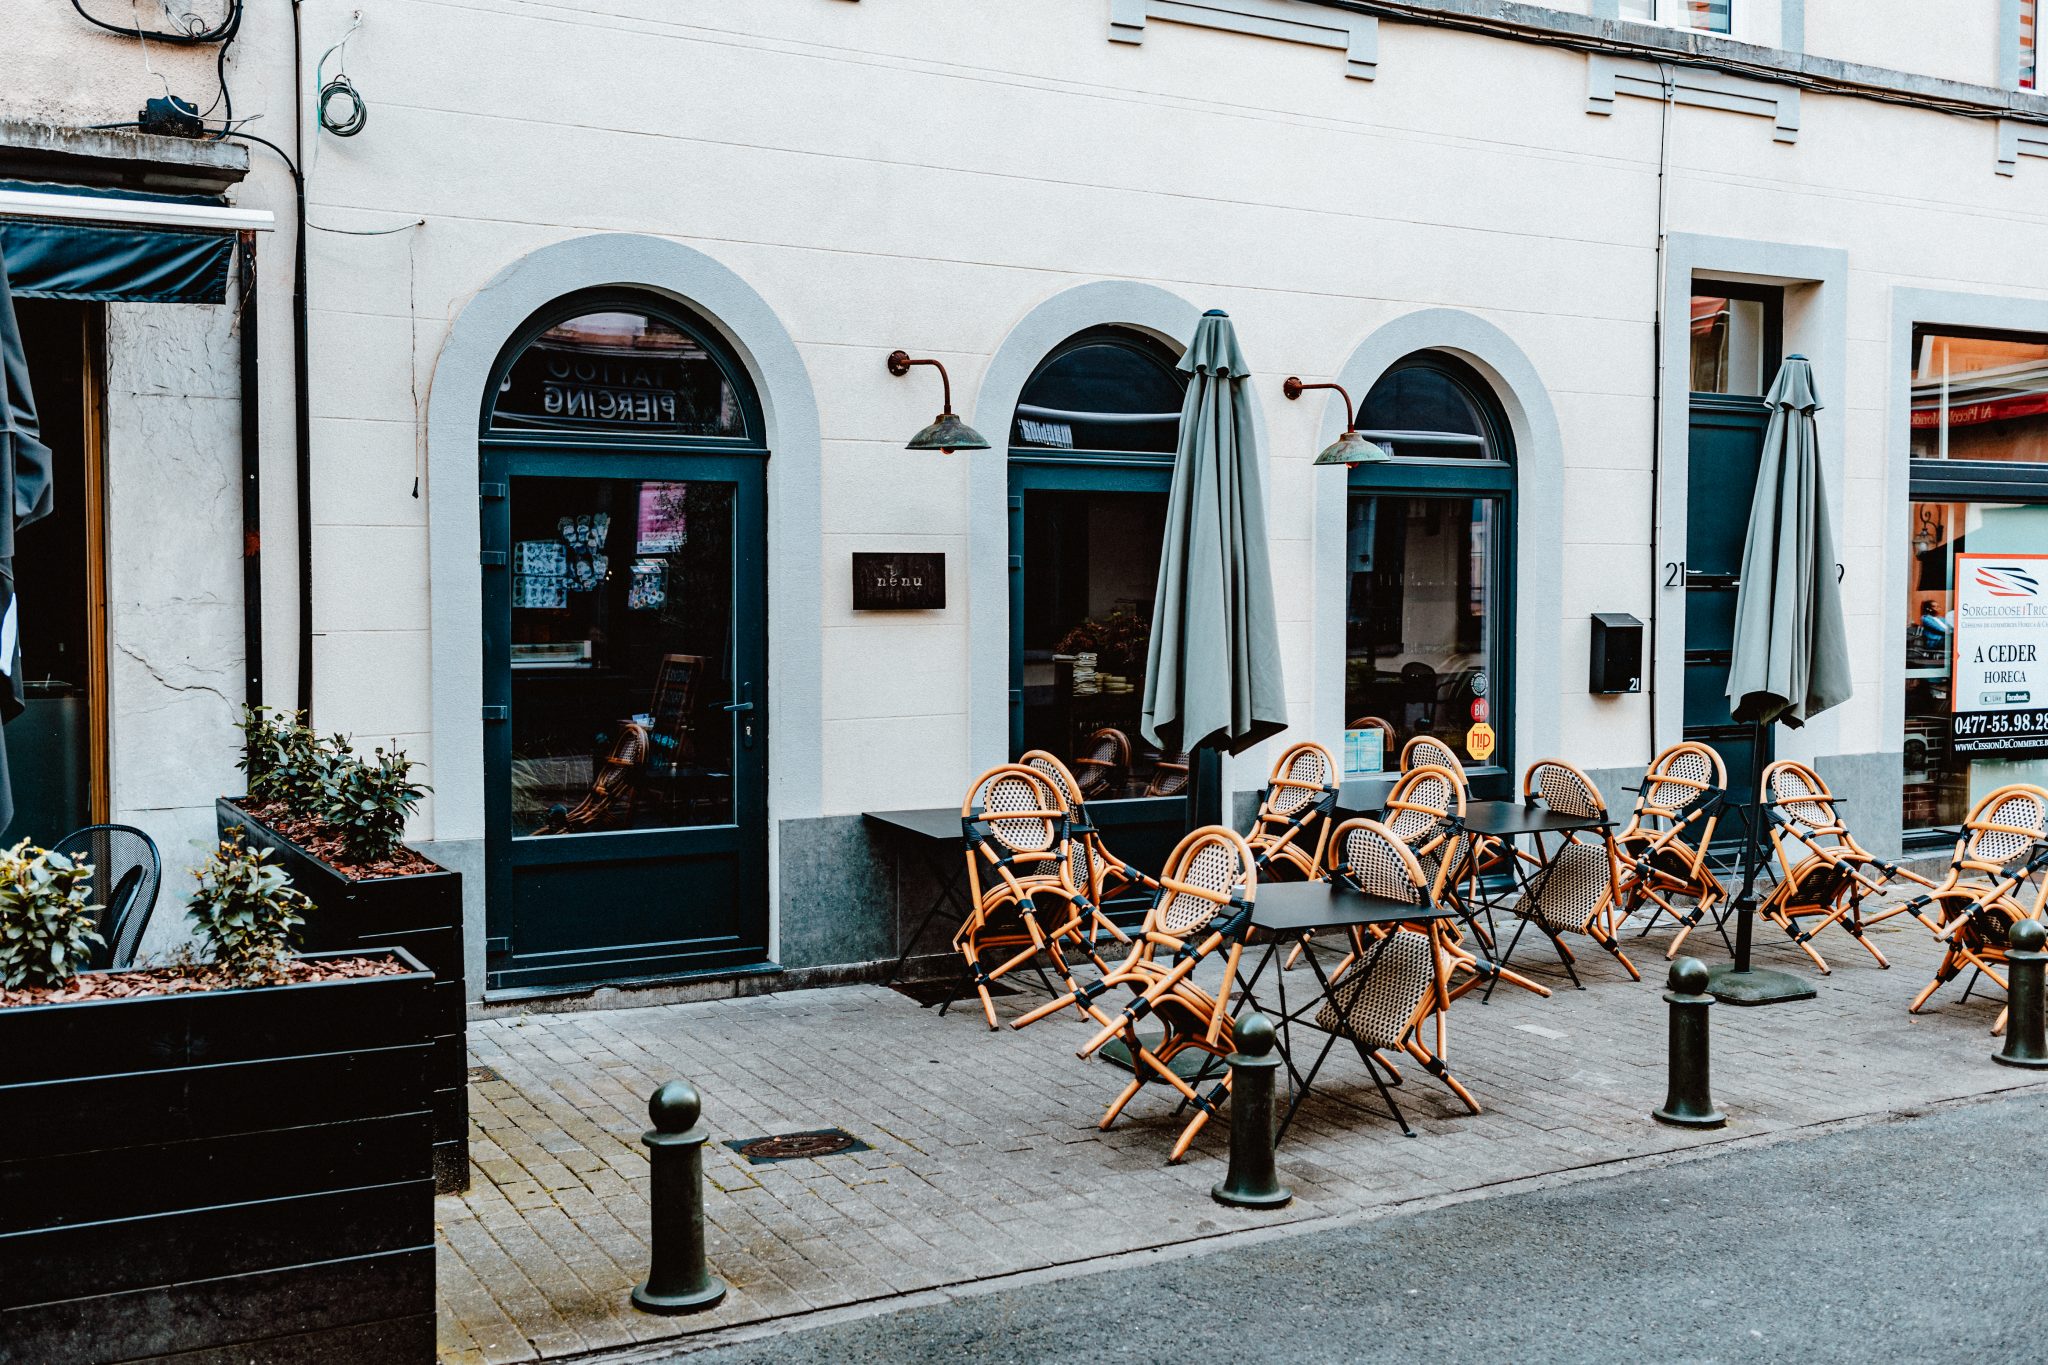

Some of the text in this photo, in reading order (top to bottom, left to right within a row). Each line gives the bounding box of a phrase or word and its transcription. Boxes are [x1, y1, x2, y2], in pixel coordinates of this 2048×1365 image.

[1664, 561, 1685, 587] 21
[1974, 644, 2038, 663] A CEDER
[1629, 677, 1640, 691] 21
[1984, 671, 2027, 684] HORECA
[1474, 703, 1485, 716] BK
